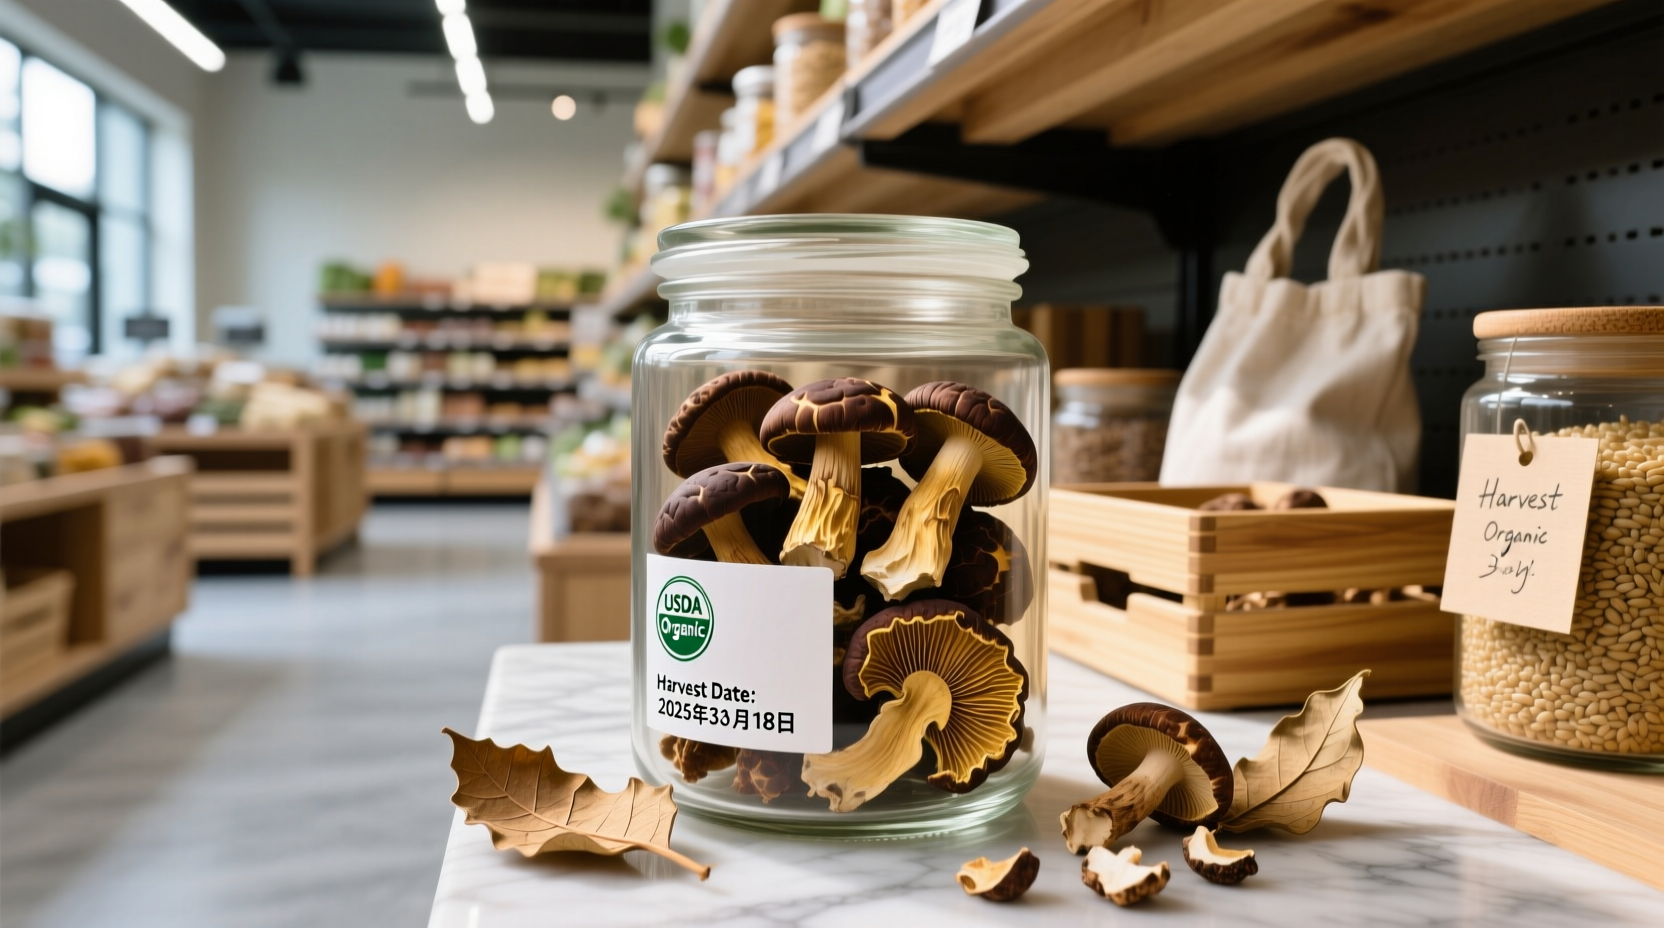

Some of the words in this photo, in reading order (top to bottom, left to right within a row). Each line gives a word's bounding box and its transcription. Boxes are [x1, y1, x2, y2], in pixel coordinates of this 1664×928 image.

[1479, 477, 1563, 511] Harvest
[1484, 521, 1548, 557] Organic
[664, 594, 702, 615] USDA
[661, 617, 706, 640] Organic
[657, 673, 707, 698] Harvest
[711, 682, 756, 704] Date:
